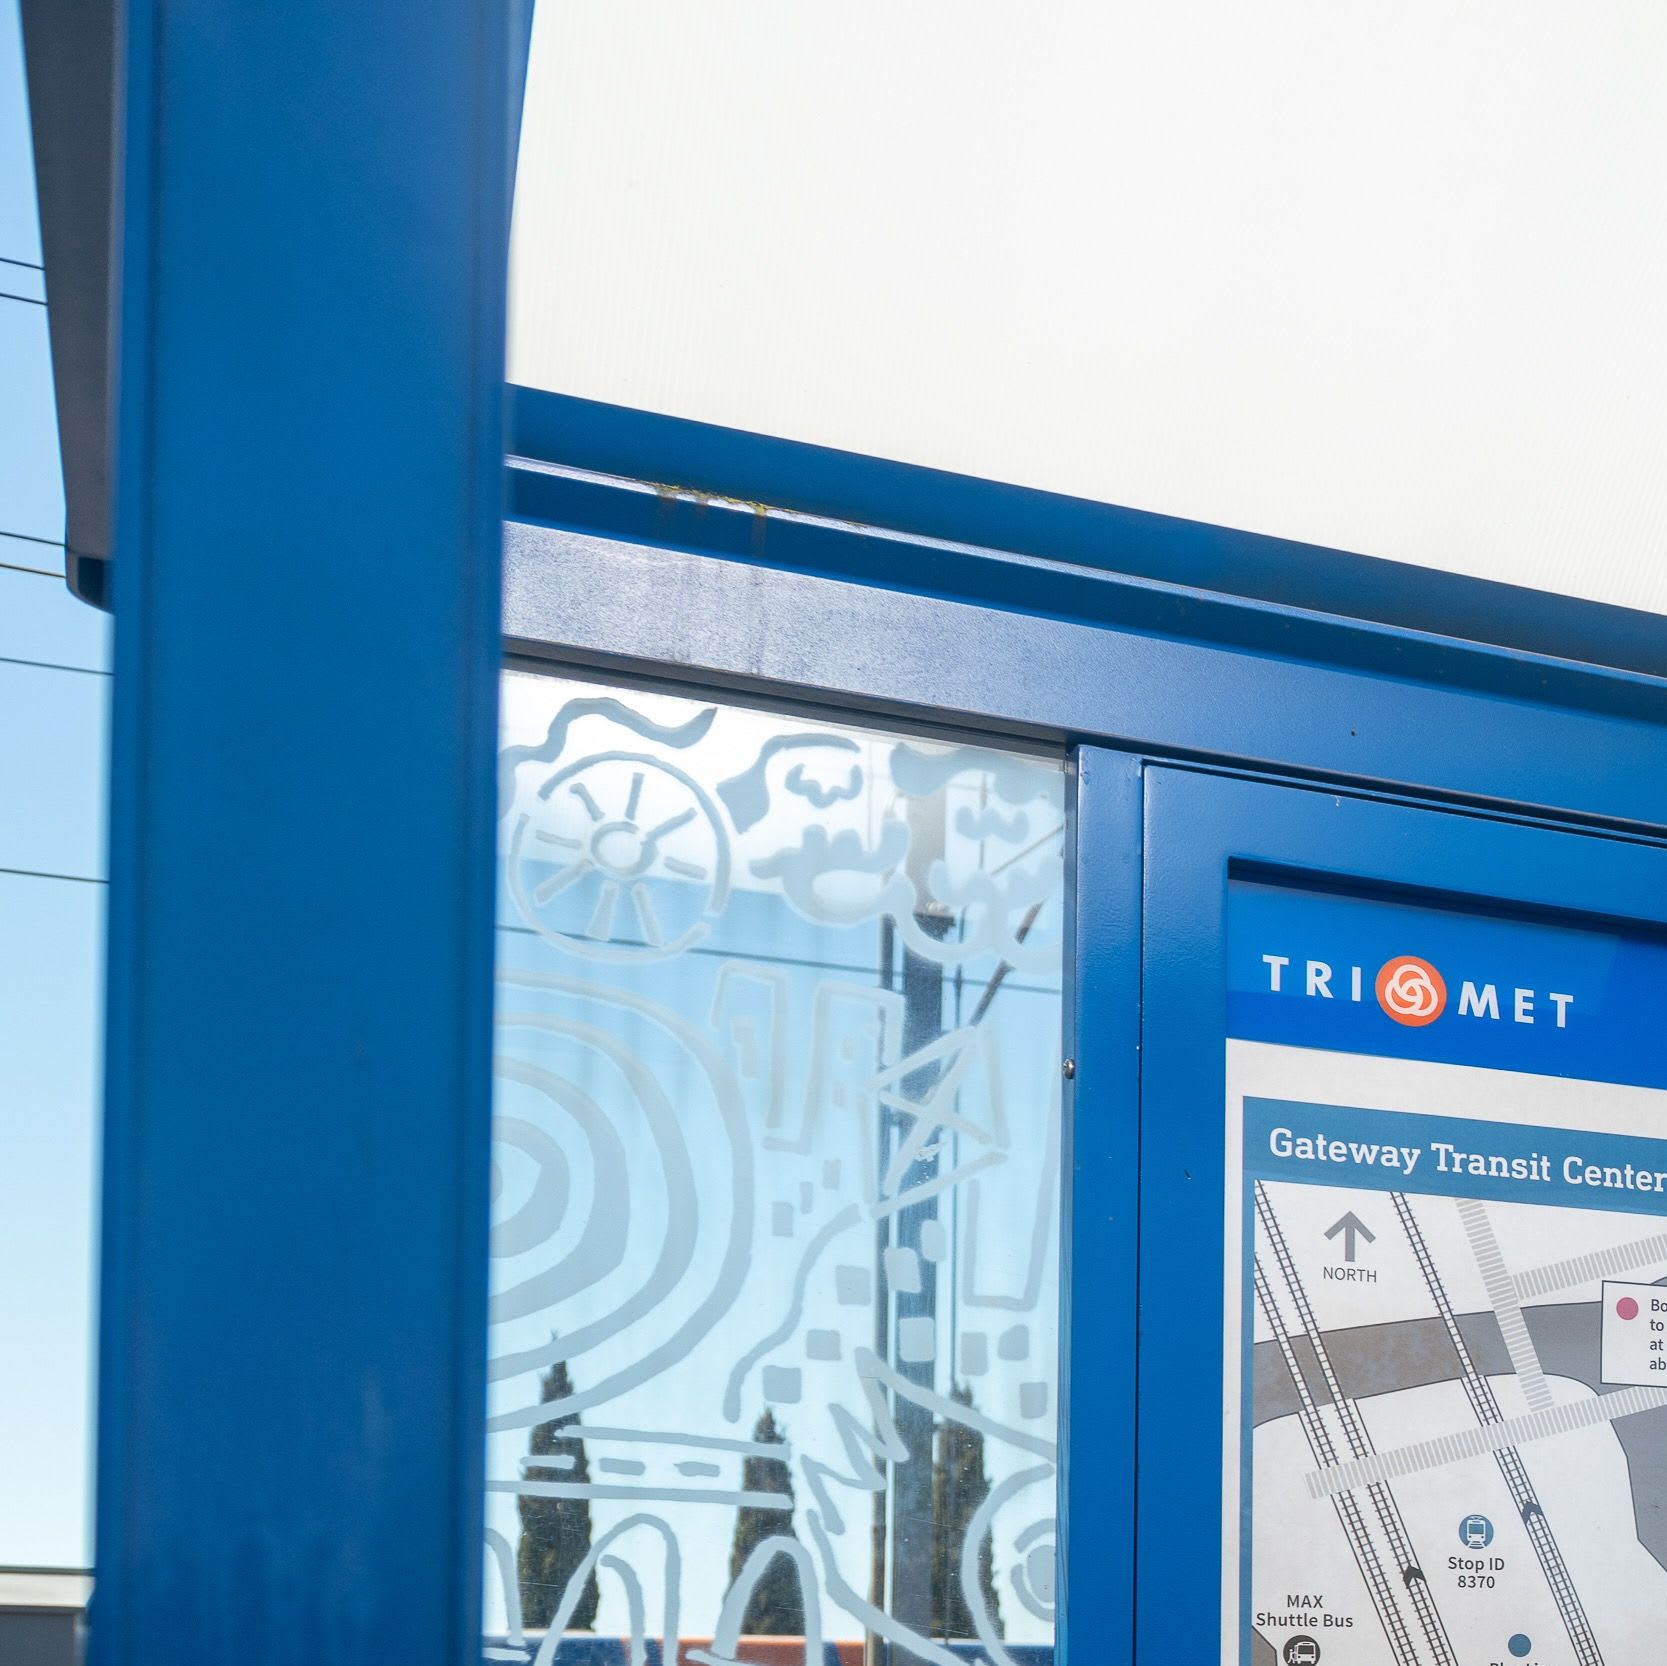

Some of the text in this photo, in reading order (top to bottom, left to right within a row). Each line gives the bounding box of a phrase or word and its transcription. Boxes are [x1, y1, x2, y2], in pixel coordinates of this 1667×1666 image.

[1270, 1128, 1667, 1192] Gateway Transit Center
[1324, 1267, 1377, 1283] NORTH
[1650, 1319, 1664, 1332] to
[1650, 1339, 1664, 1351] at
[1448, 1557, 1505, 1574] Stop ID
[1458, 1575, 1495, 1589] 8370
[1288, 1595, 1323, 1608] MAX
[1256, 1612, 1353, 1628] Shuttle Bus
